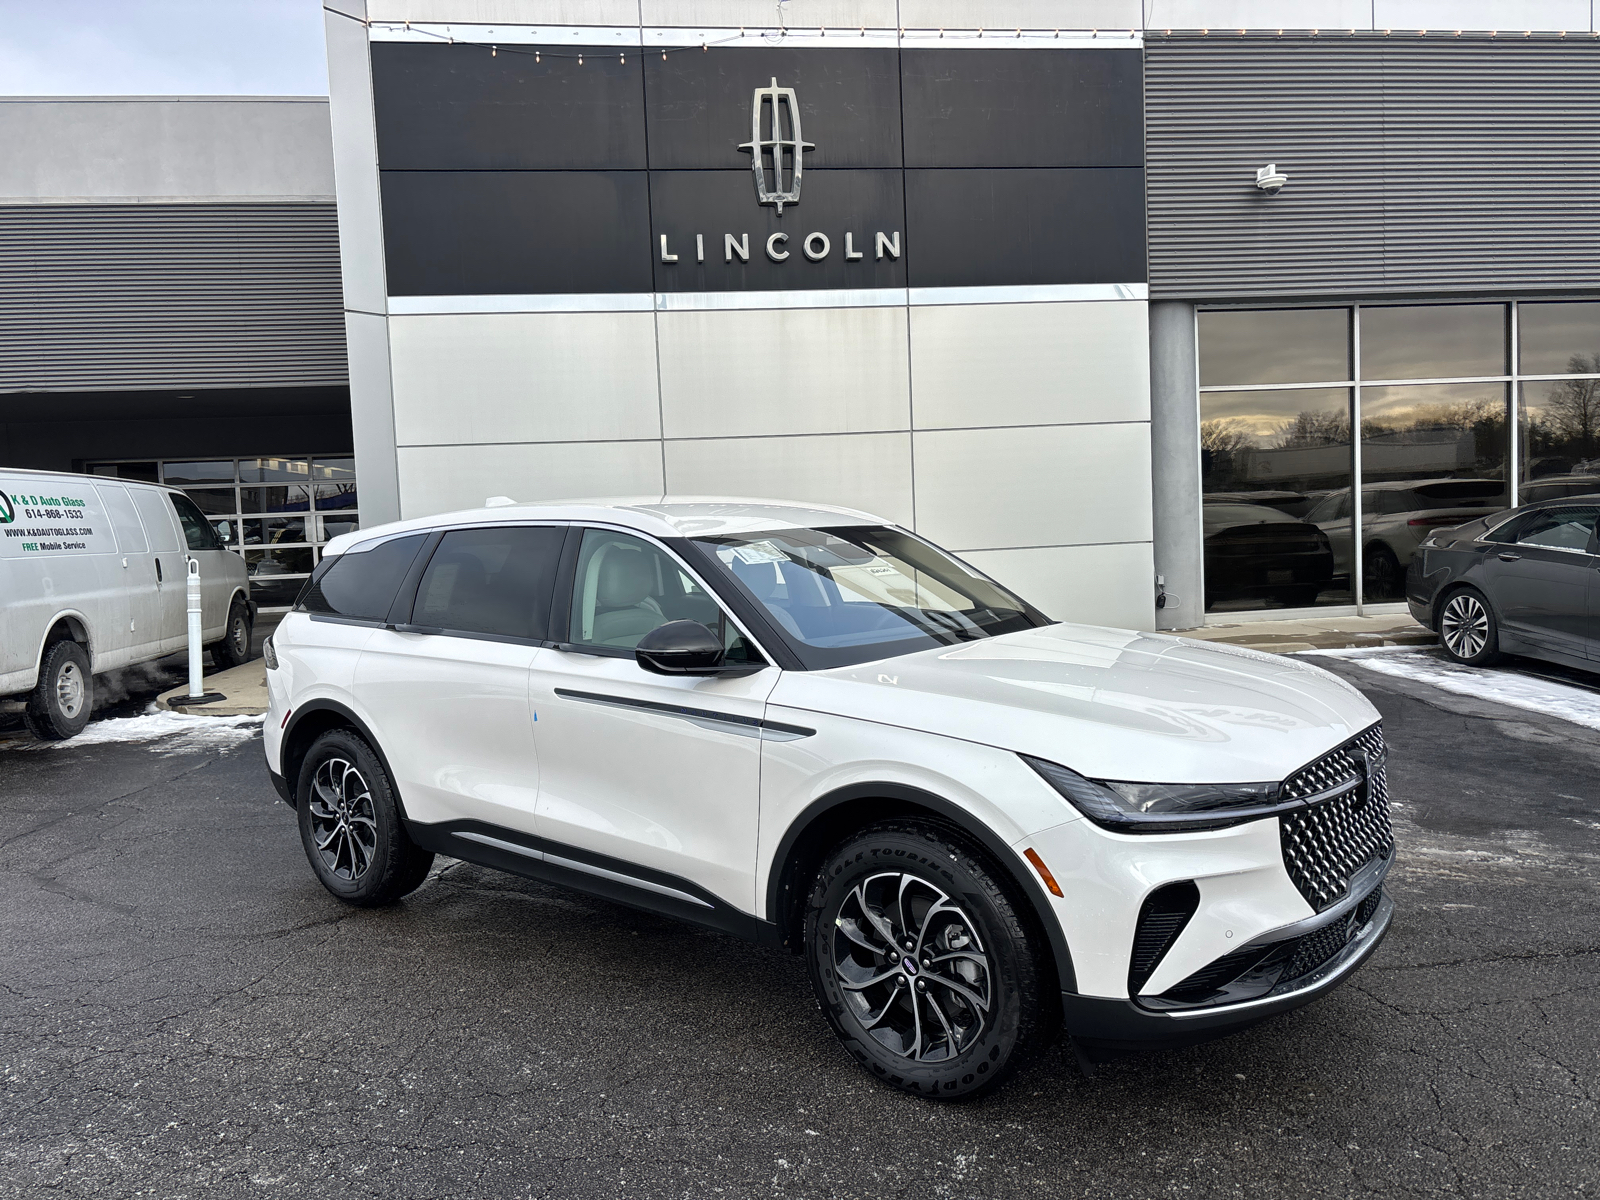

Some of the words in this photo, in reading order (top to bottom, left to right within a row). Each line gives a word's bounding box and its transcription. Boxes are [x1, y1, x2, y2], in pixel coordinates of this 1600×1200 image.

[660, 231, 900, 263] LINCOLN
[10, 495, 20, 505] K
[21, 495, 30, 506] &
[29, 495, 38, 506] D
[39, 495, 61, 507] Auto
[61, 496, 86, 507] Glass
[25, 508, 84, 519] 614-868-1533
[4, 528, 93, 537] WWW.K&DAUTOGLASS.COM
[22, 542, 39, 552] FREE
[40, 542, 62, 550] Mobile
[62, 541, 86, 550] Service
[680, 707, 758, 725] NAUTILUS
[869, 847, 955, 885] TOURING
